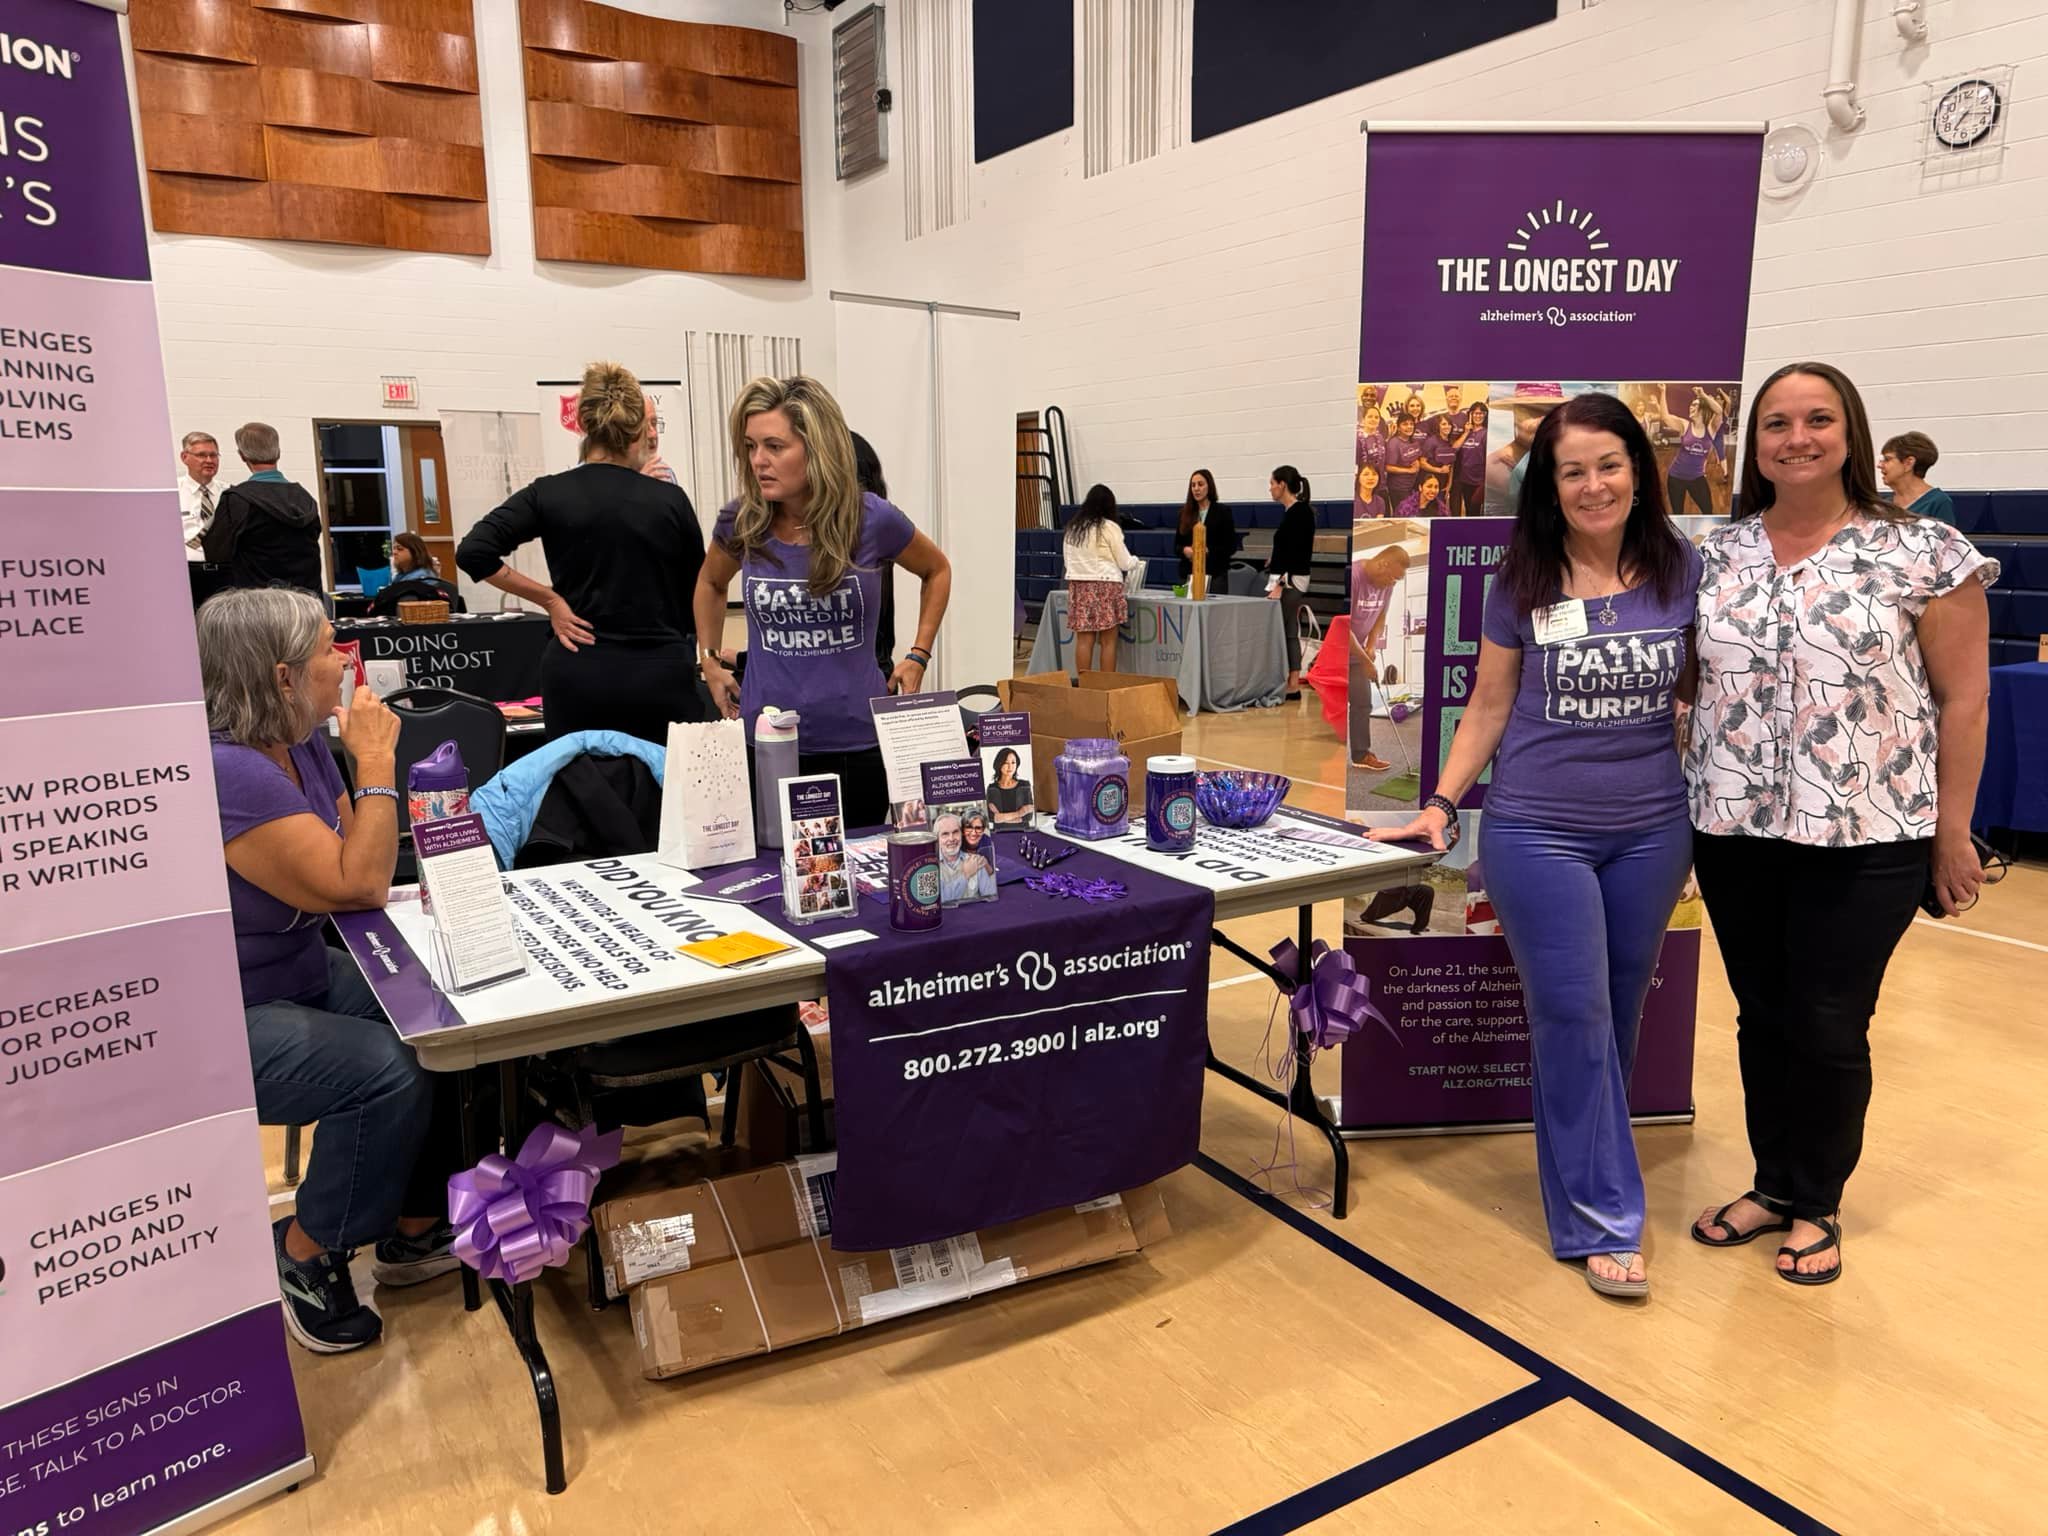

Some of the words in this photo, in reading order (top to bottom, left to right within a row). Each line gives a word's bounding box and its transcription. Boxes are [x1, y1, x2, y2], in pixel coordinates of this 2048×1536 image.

[1438, 258, 1490, 292] THE
[1498, 258, 1618, 292] LONGEST
[1480, 309, 1544, 322] alzheimer's
[0, 358, 94, 384] NNING
[0, 389, 86, 412] LVING
[388, 384, 408, 400] EXIT
[1446, 546, 1476, 566] THE
[24, 587, 91, 607] TIME
[754, 586, 852, 611] PAINT
[0, 616, 85, 639] PLACE
[758, 609, 854, 624] DUNEDIN
[374, 632, 458, 656] DOING
[766, 625, 855, 649] PURPLE
[430, 650, 495, 673] MOST
[1556, 637, 1677, 676] PAINT
[1442, 665, 1468, 700] IS
[1556, 667, 1680, 693] DUNEDIN
[1558, 689, 1671, 720] PURPLE
[1575, 720, 1595, 728] FOR
[44, 764, 190, 798] PROBLEMS
[930, 772, 979, 782] UNDERSTANDING
[946, 787, 974, 796] DEMENTIA
[54, 796, 158, 824] WORDS
[12, 824, 148, 860] SPEAKING
[446, 832, 459, 840] FOR
[460, 828, 480, 836] LIVING
[425, 843, 442, 852] WITH
[28, 852, 148, 887] WRITING
[1194, 860, 1270, 882] DID
[560, 879, 583, 891] WE
[584, 859, 640, 882] DID
[616, 880, 684, 910] YOU
[571, 888, 618, 918] PROVIDE
[524, 878, 584, 919] INFORMATION
[570, 918, 600, 932] AND
[589, 932, 630, 958] TOOLS
[621, 956, 650, 975] FOR
[613, 921, 657, 950] WEALTH
[526, 911, 554, 926] AND
[542, 924, 582, 950] THOSE
[568, 947, 604, 969] WHO
[590, 968, 630, 990] HELP
[648, 950, 676, 961] OF
[528, 947, 586, 992] DECISIONS.
[1389, 966, 1408, 977] On
[1411, 965, 1442, 977] June
[1445, 964, 1465, 977] 21,
[1468, 964, 1488, 975] the
[868, 964, 1010, 1008] alzheimer's
[1384, 983, 1404, 994] the
[1407, 981, 1460, 994] darkness
[1464, 981, 1476, 992] of
[0, 977, 160, 1029] DECREASED
[1402, 1000, 1424, 1011] and
[1428, 998, 1472, 1012] passion
[1476, 1000, 1488, 1009] to
[1492, 997, 1520, 1008] raise
[1, 1032, 42, 1056] OR
[52, 1010, 131, 1044] POOR
[1400, 1016, 1418, 1028] for
[1422, 1016, 1442, 1028] the
[1445, 1018, 1474, 1028] care,
[1477, 1015, 1523, 1028] support
[1432, 1032, 1446, 1044] of
[1449, 1032, 1469, 1043] the
[6, 1030, 158, 1085] JUDGMENT
[903, 1031, 1065, 1080] 800.272.3900
[1408, 1066, 1445, 1076] START
[1448, 1064, 1480, 1074] NOW.
[1483, 1063, 1526, 1074] SELECT
[30, 1194, 160, 1250] CHANGES
[166, 1182, 192, 1205] IN
[34, 1234, 122, 1278] MOOD
[130, 1214, 185, 1246] AND
[38, 1226, 219, 1305] PERSONALITY
[1, 1416, 81, 1460] THESE
[84, 1386, 152, 1428] SIGNS
[156, 1375, 179, 1398] IN
[28, 1446, 88, 1482] TALK
[91, 1431, 124, 1456] TO
[130, 1423, 146, 1441] A
[150, 1379, 246, 1432] DOCTOR.
[56, 1506, 86, 1527] to
[92, 1472, 157, 1513] learn
[163, 1440, 232, 1481] more.
